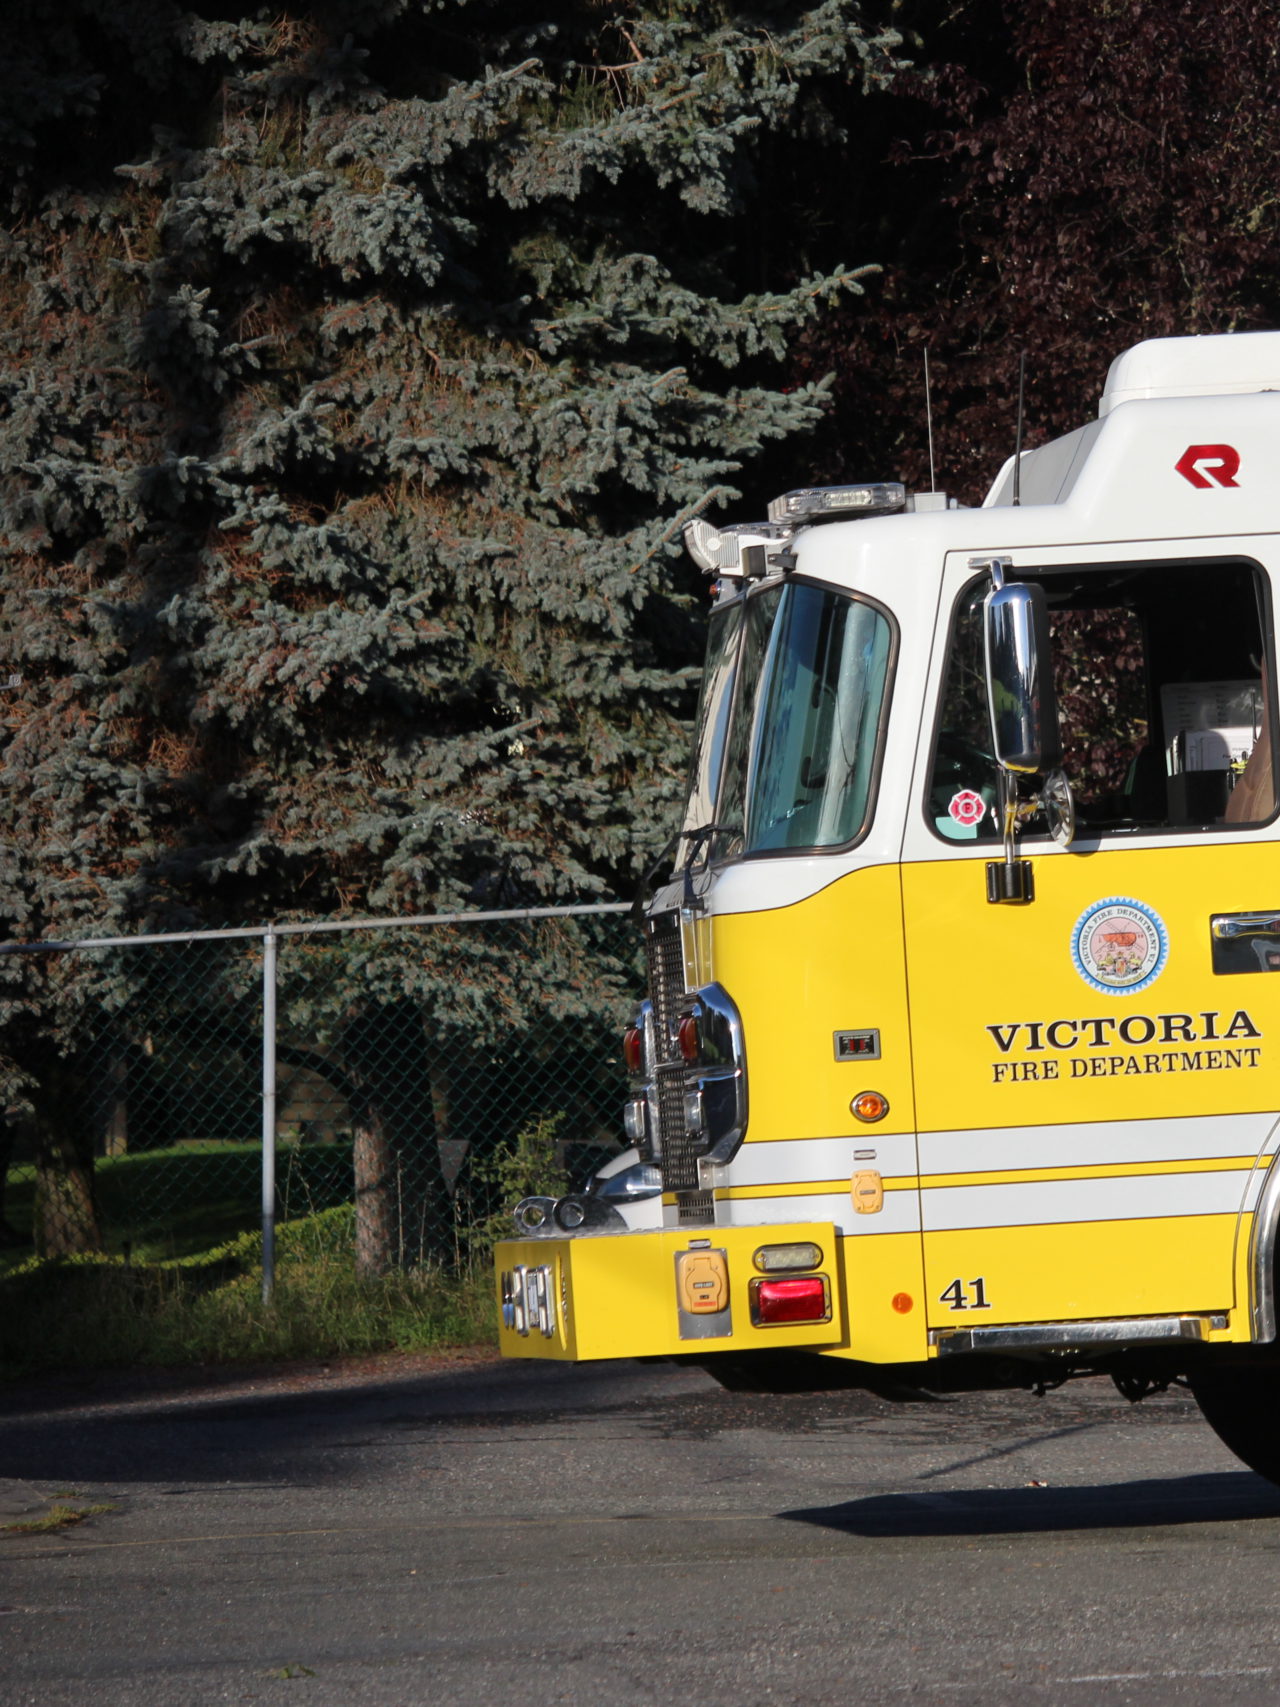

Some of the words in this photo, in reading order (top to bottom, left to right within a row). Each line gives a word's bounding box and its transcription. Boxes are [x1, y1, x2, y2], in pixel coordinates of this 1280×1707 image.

[1092, 908, 1113, 925] FIRE
[986, 1010, 1262, 1052] VICTORIA
[992, 1060, 1059, 1082] FIRE
[1070, 1048, 1261, 1078] DEPARTMENT
[939, 1277, 991, 1310] 41
